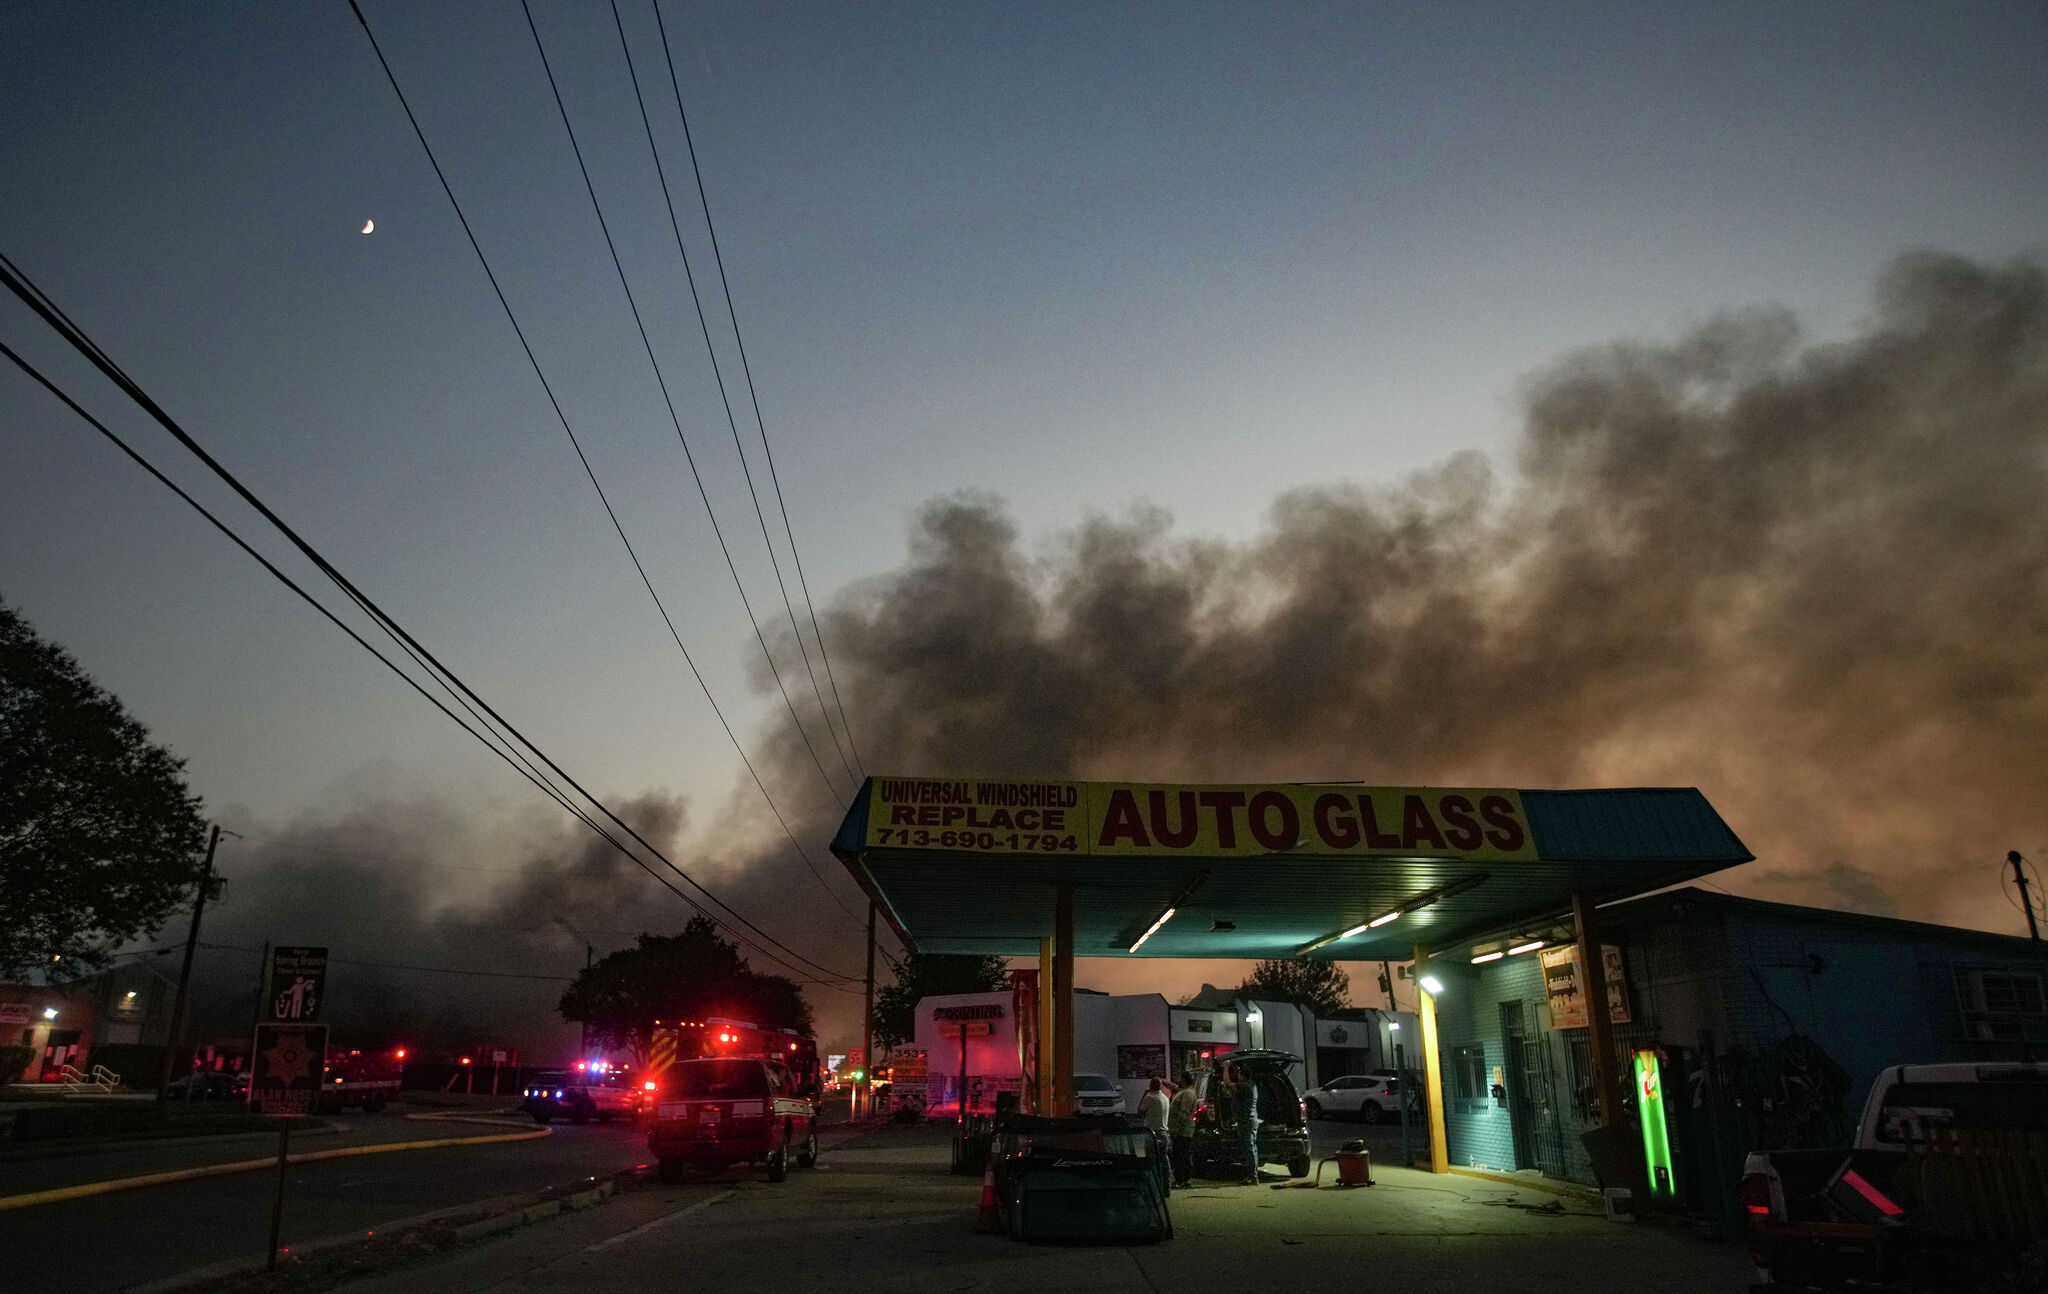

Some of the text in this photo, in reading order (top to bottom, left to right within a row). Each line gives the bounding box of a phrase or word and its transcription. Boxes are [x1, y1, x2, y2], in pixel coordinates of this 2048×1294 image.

[881, 780, 1078, 807] UNIVERSAL WINDSHIELD
[891, 805, 1065, 830] REPLACE
[1098, 789, 1525, 851] AUTO GLASS
[876, 828, 1078, 850] 713-690-1794
[894, 1050, 928, 1058] 3535
